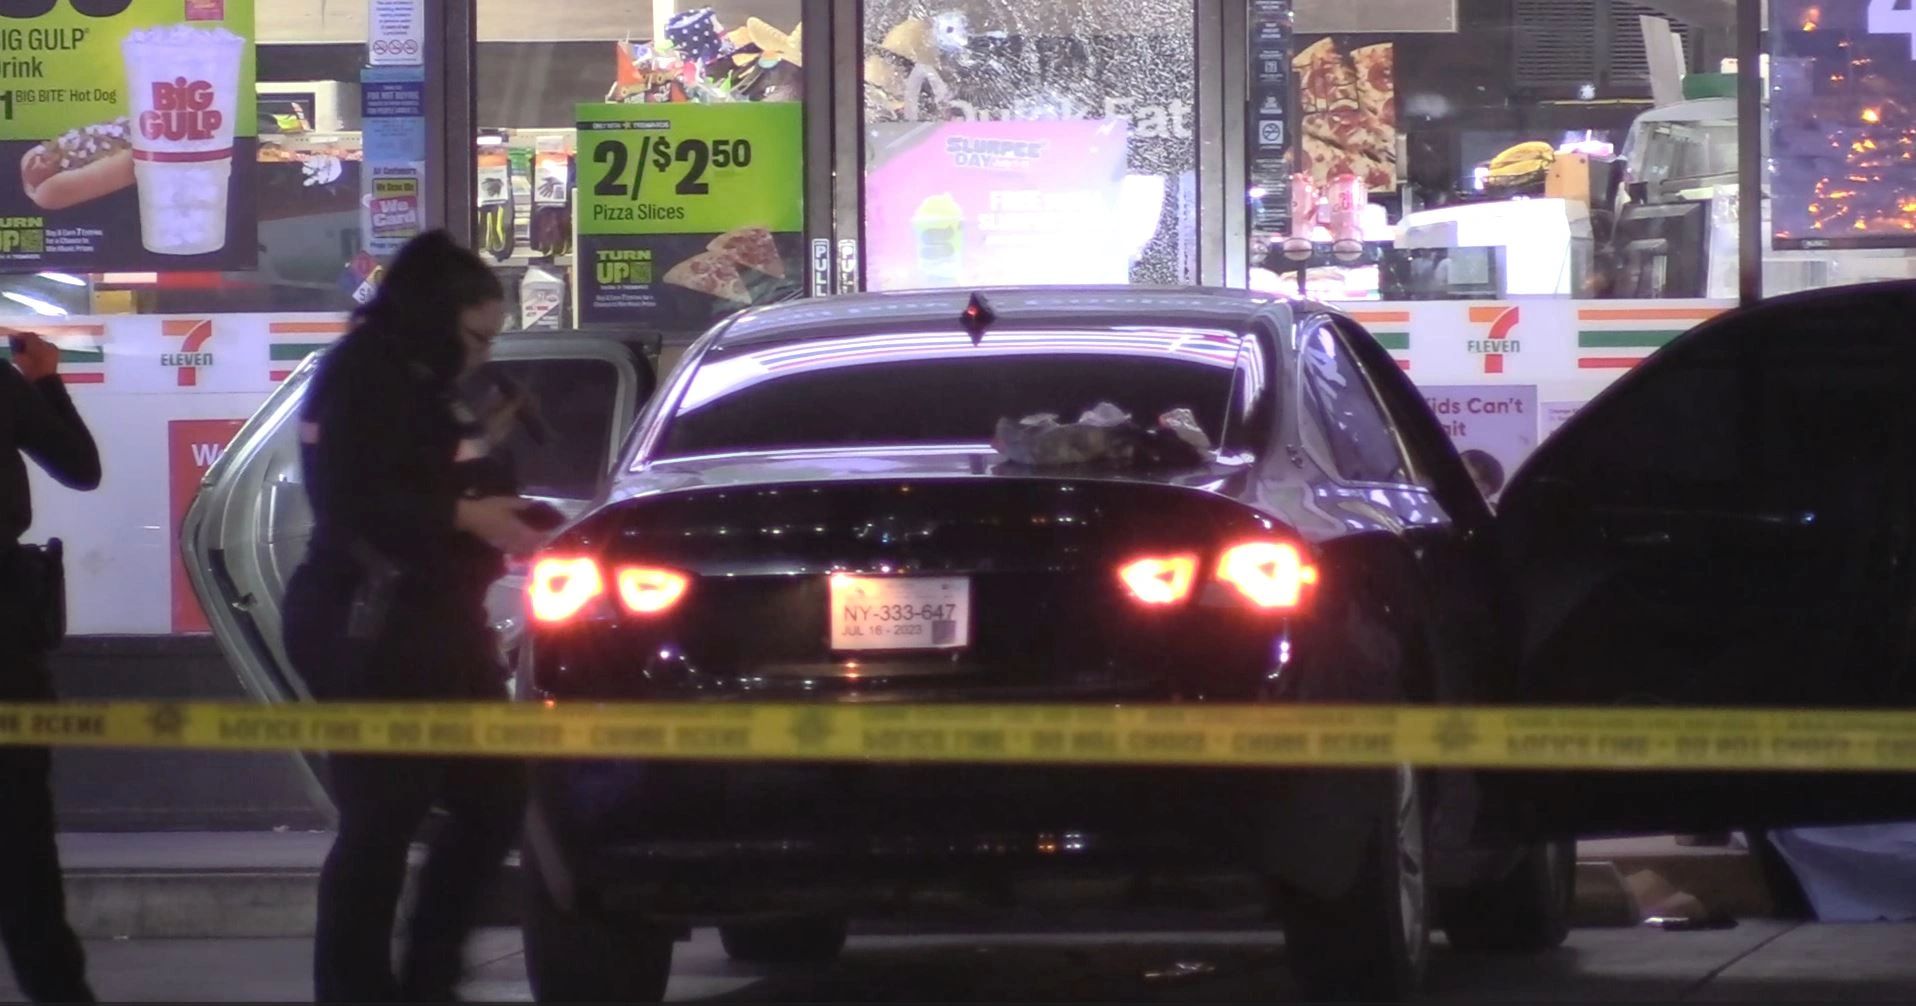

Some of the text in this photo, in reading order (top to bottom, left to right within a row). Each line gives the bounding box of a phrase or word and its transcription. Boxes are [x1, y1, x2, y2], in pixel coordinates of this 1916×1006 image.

[0, 28, 22, 50] IG
[0, 57, 43, 78] rink
[16, 91, 37, 102] BIG
[70, 90, 90, 101] Hot
[94, 89, 116, 103] Dog
[139, 110, 222, 141] GULP
[955, 153, 991, 166] DAY
[593, 203, 684, 220] Pizza Slices
[0, 217, 43, 228] URN
[596, 250, 651, 260] TURN
[597, 262, 630, 284] UP
[815, 246, 827, 297] PULL
[1469, 306, 1519, 373] 7
[162, 320, 212, 386] 7
[1428, 397, 1524, 414] ids Can't
[1443, 420, 1466, 437] ait
[844, 604, 956, 621] NY-333-647
